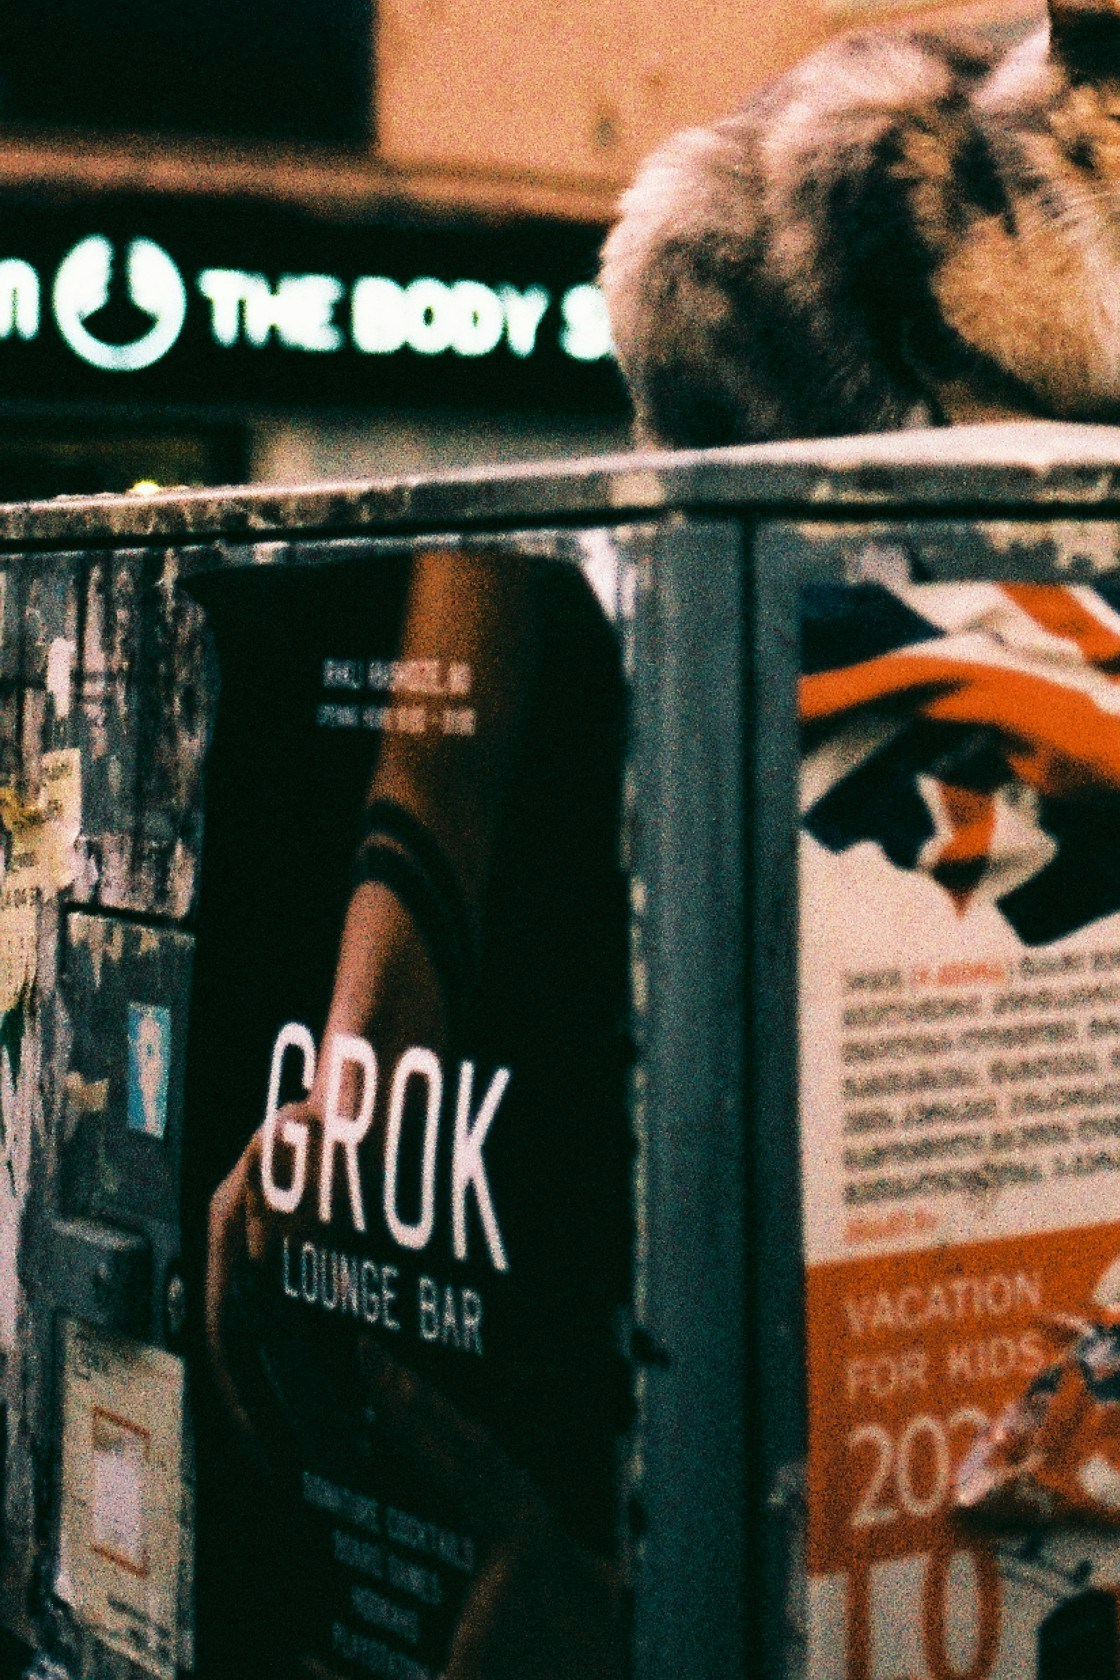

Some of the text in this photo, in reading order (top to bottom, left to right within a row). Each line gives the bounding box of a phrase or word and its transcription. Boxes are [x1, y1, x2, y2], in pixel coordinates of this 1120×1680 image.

[198, 267, 343, 352] THE
[351, 275, 548, 359] BODY
[262, 1021, 512, 1272] GROK
[283, 1237, 485, 1358] LOUNGE BAR
[848, 1272, 1044, 1338] VACATION
[848, 1332, 1045, 1403] FOR KIDS
